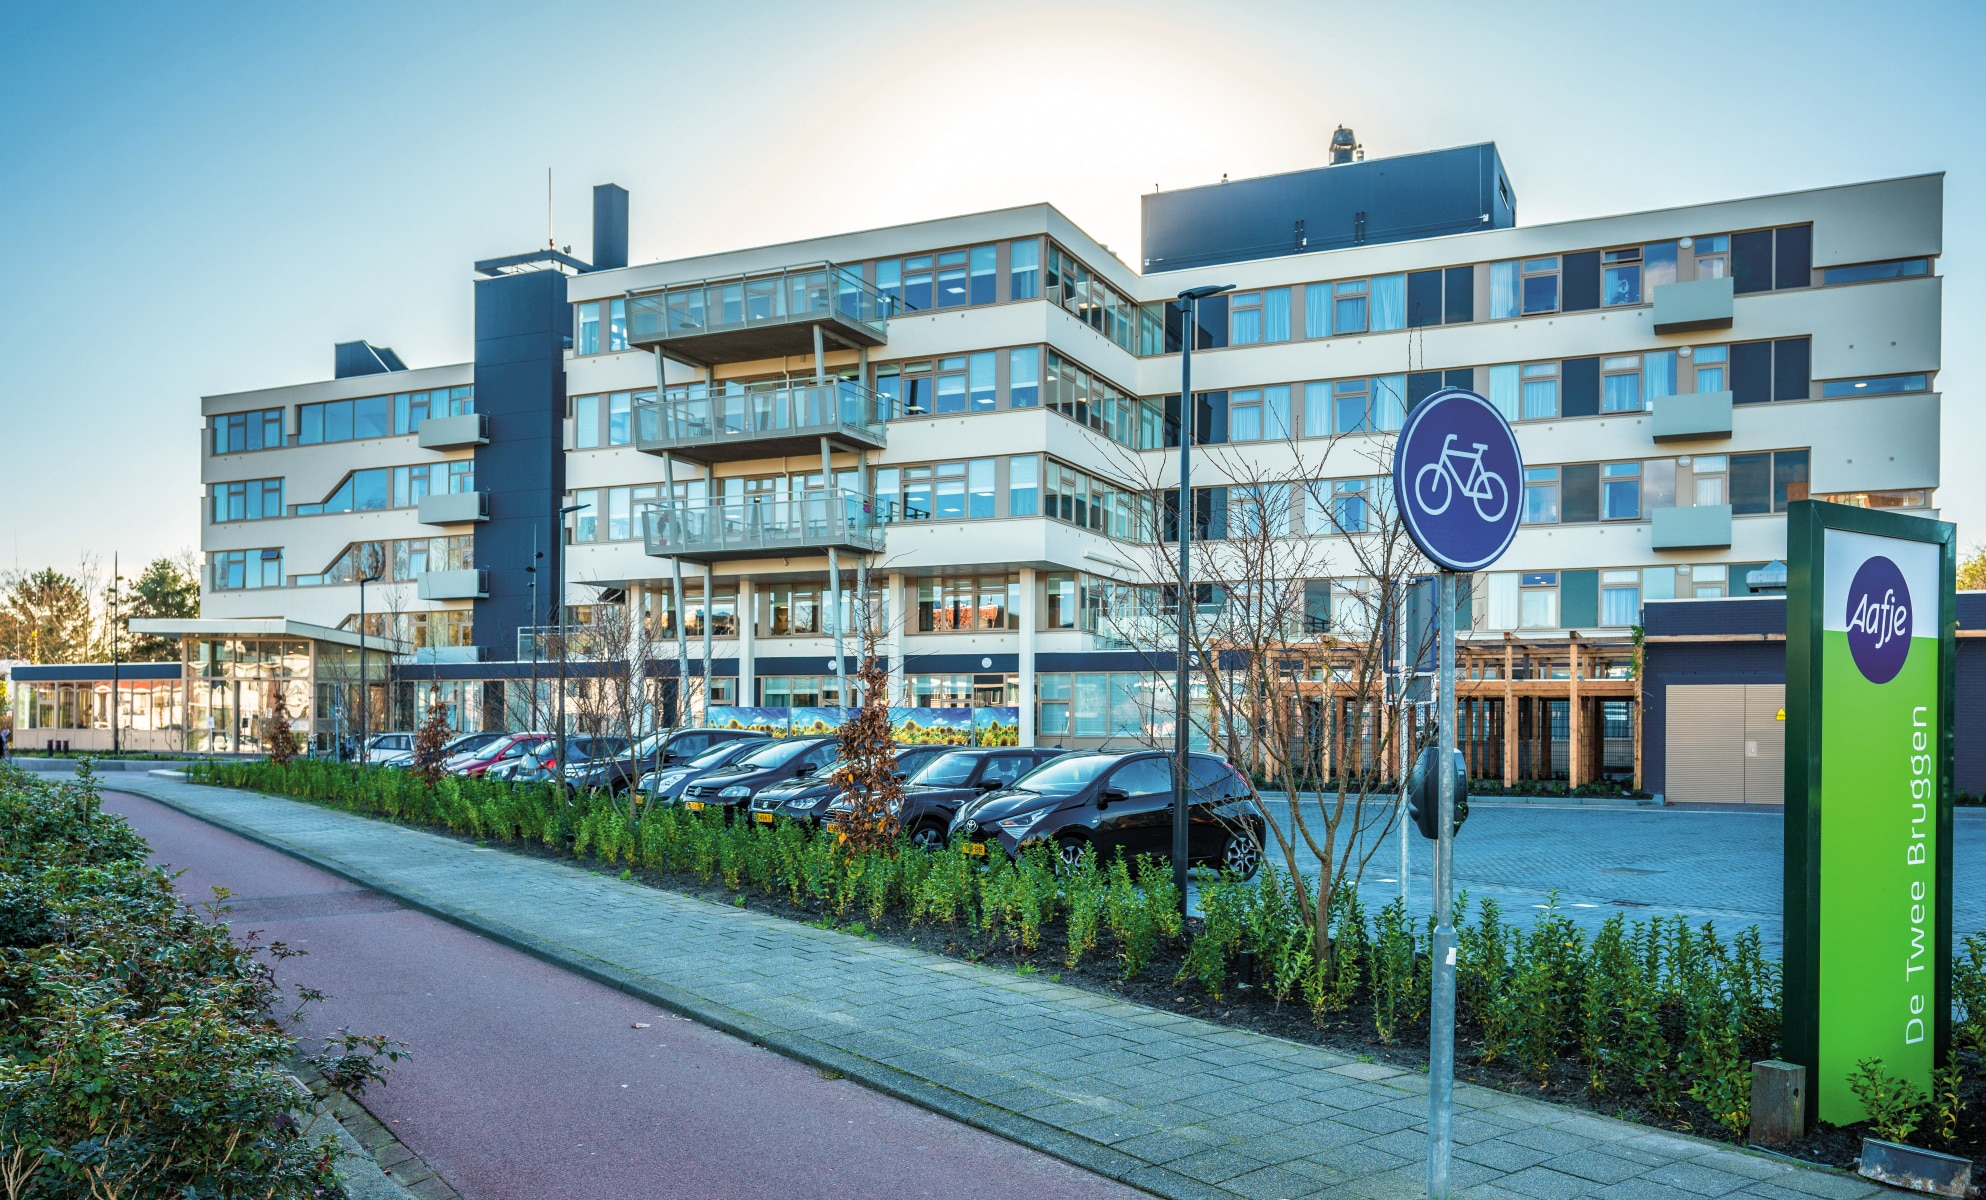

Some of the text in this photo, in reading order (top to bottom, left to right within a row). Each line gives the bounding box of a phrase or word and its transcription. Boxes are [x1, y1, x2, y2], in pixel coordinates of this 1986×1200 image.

[1846, 588, 1907, 649] Aafje
[1905, 706, 1931, 1045] De Twee Bruggen
